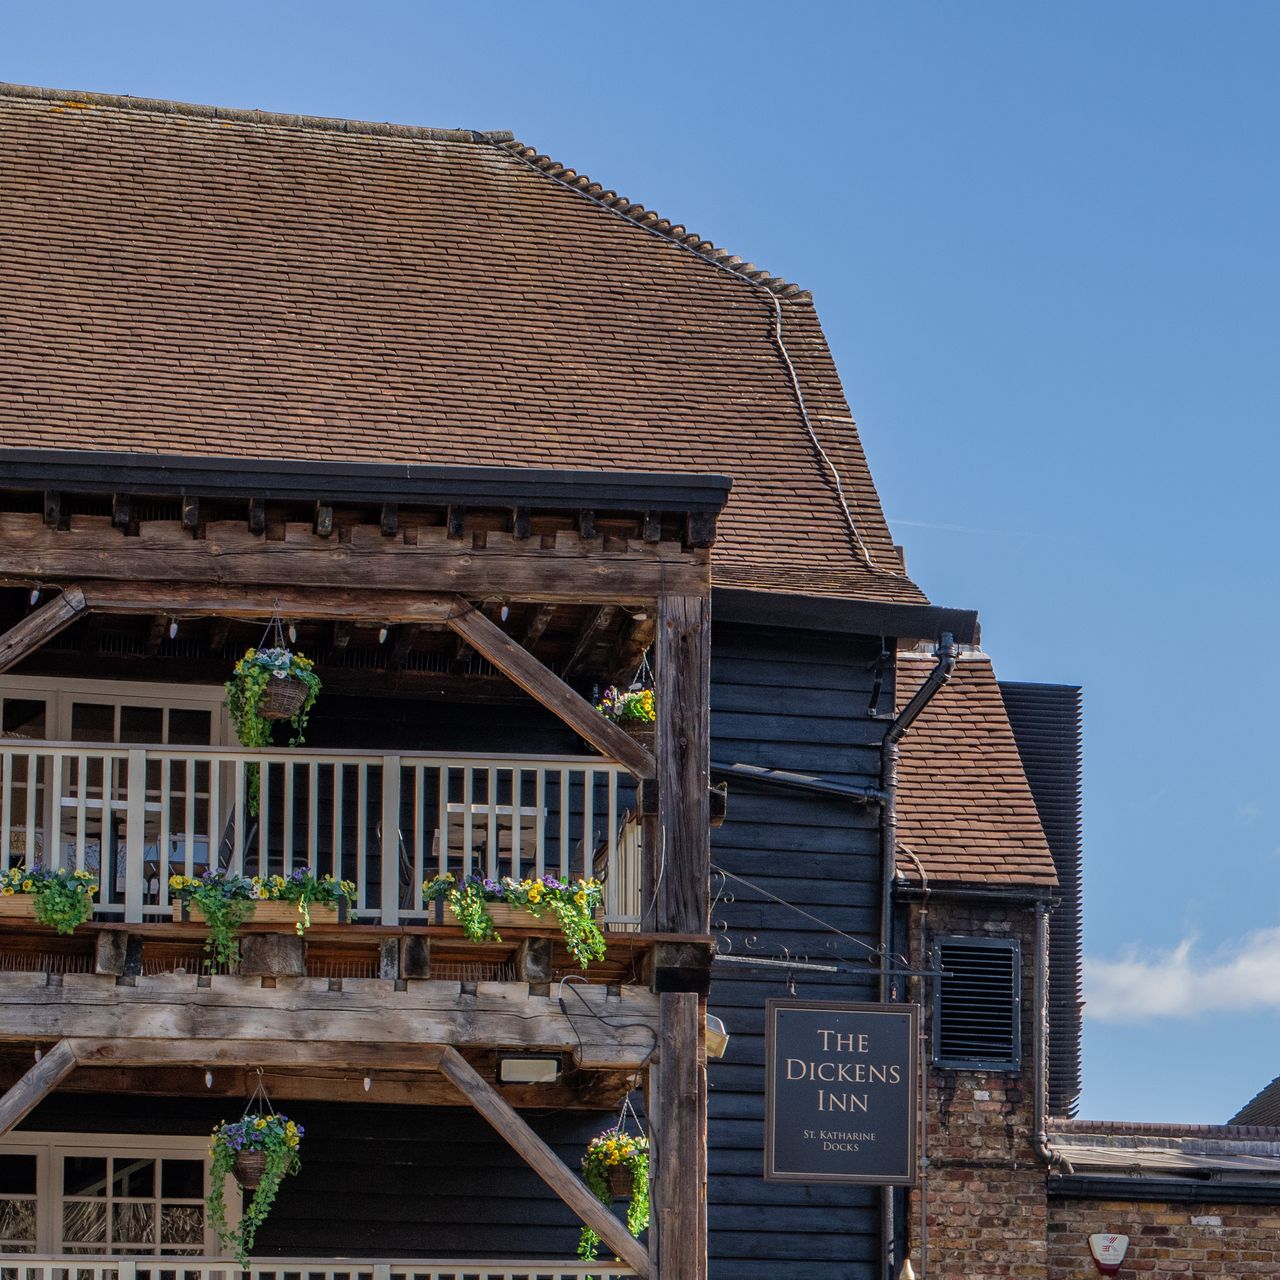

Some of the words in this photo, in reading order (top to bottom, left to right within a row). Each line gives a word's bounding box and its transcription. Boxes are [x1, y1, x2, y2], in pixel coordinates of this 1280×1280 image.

[817, 1030, 869, 1052] THE
[786, 1059, 901, 1084] DICKENS
[817, 1090, 869, 1112] INN
[820, 1130, 876, 1141] KATHARINE
[823, 1142, 859, 1151] DOCKS
